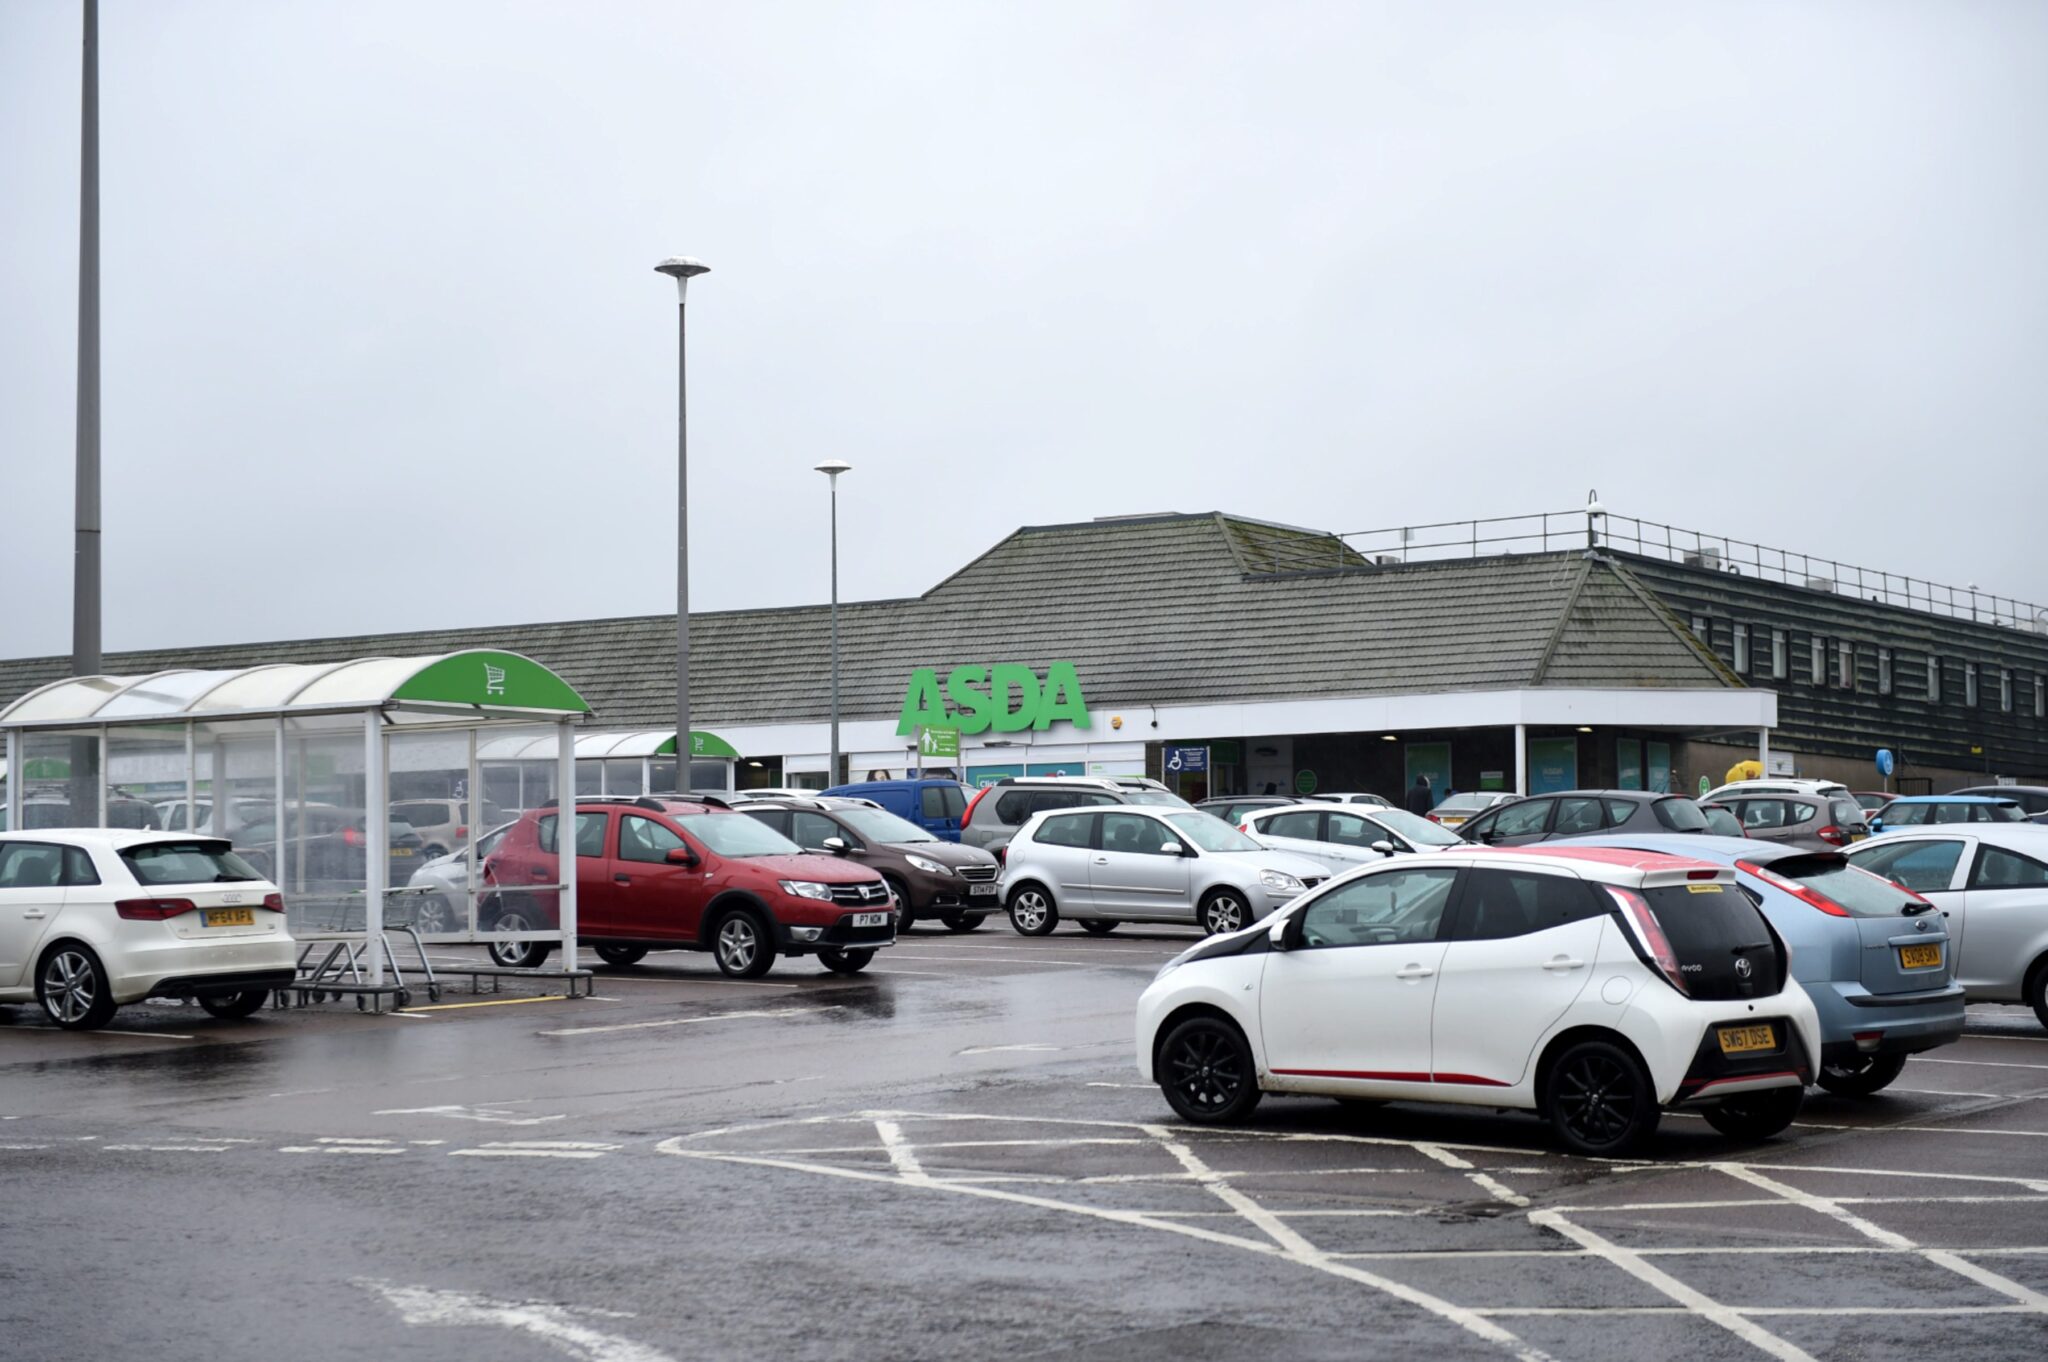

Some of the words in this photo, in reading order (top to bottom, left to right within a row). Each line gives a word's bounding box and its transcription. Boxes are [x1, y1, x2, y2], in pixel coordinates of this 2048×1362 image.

[896, 661, 1091, 737] ASDA
[859, 914, 869, 925] P7
[1721, 1029, 1748, 1049] SW67
[1748, 1027, 1771, 1046] DSE
